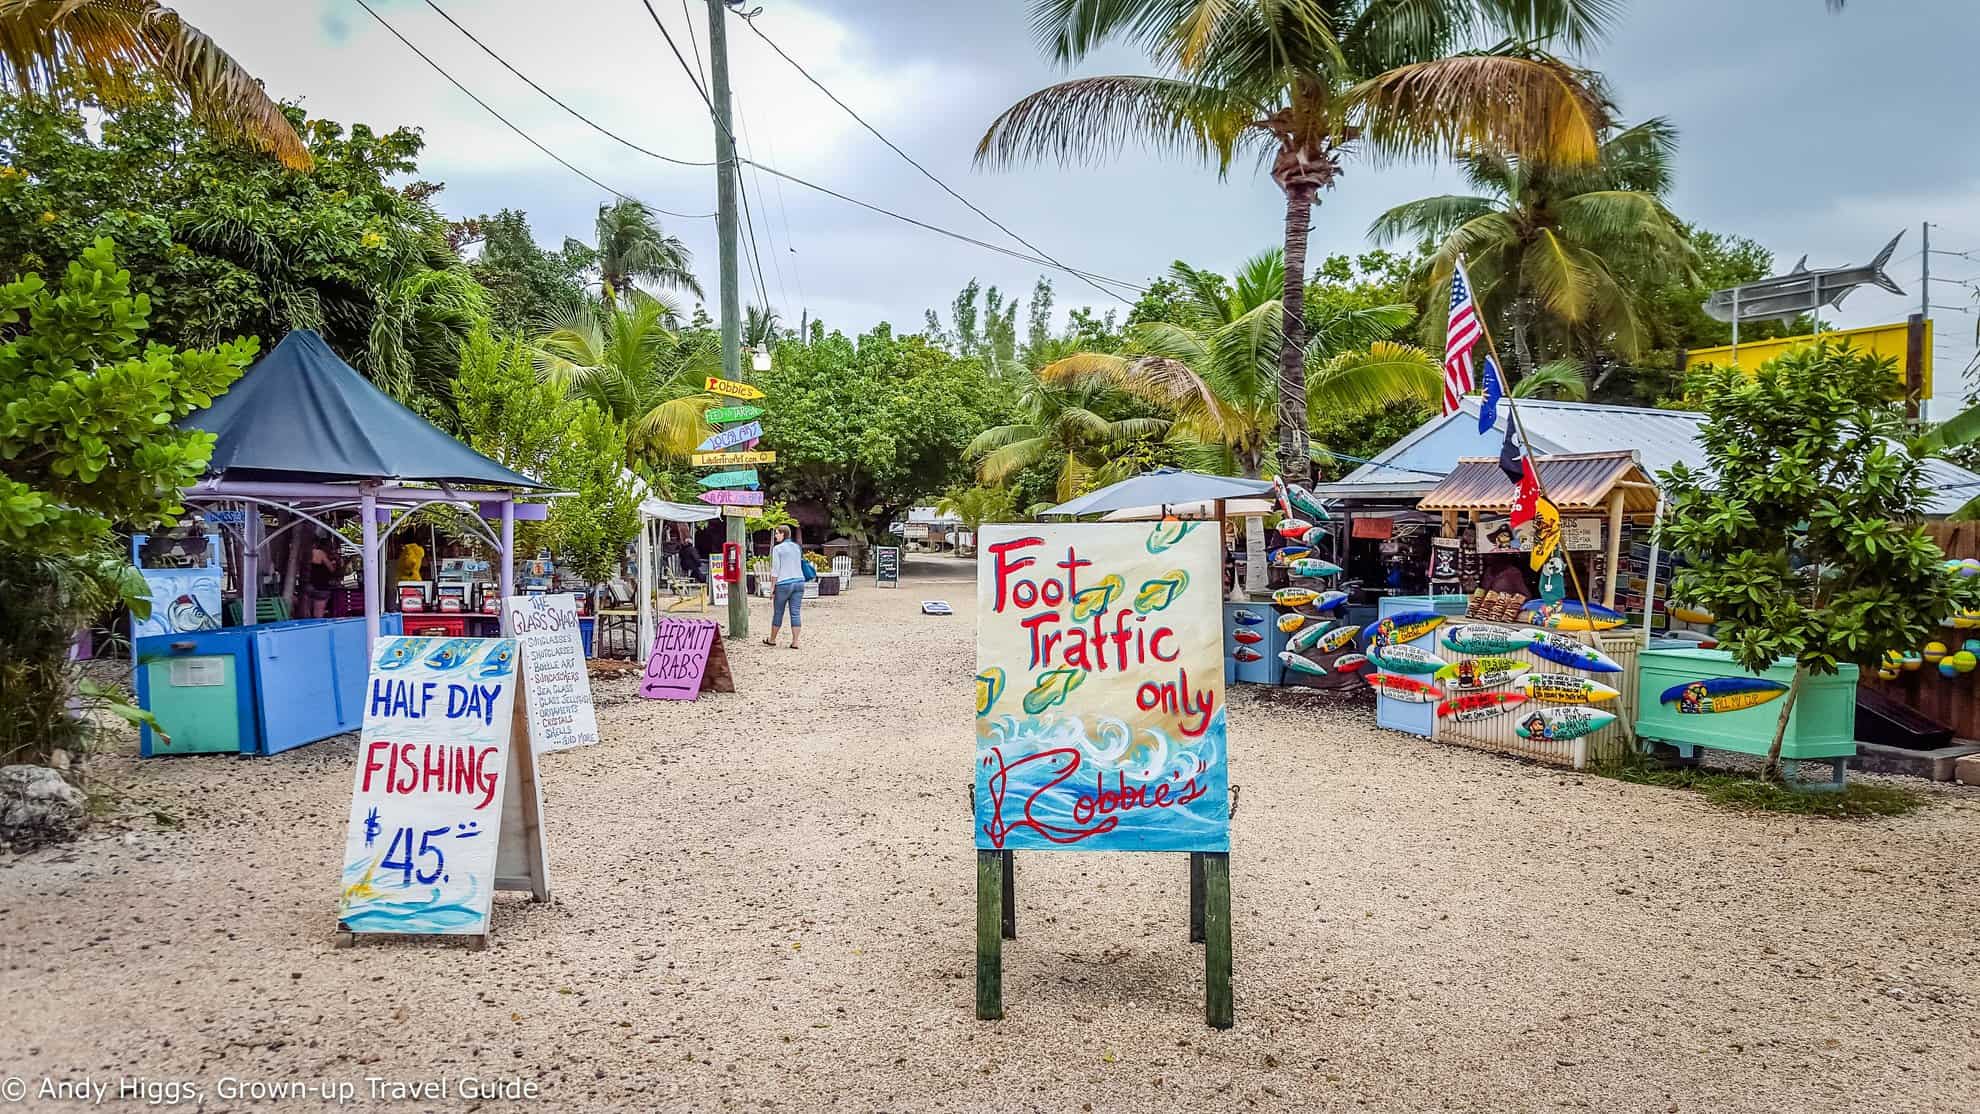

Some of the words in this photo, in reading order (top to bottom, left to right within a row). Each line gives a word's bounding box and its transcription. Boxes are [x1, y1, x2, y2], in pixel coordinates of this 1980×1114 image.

[709, 430, 737, 450] LOCAL
[739, 422, 758, 438] ART
[988, 536, 1093, 614] Foot
[528, 596, 550, 612] THE
[512, 610, 548, 636] GLASS
[655, 622, 715, 653] HERMIT
[1020, 608, 1181, 673] Traffic
[561, 657, 576, 669] ART
[648, 652, 703, 680] CRABS
[371, 678, 437, 719] HALF
[446, 684, 501, 727] DAY
[536, 685, 552, 696] SEA
[553, 683, 574, 695] GLASS
[1136, 667, 1214, 737] only
[1716, 699, 1731, 711] FILL
[1744, 695, 1759, 706] CUP
[545, 725, 573, 739] SHELLS
[577, 732, 596, 744] MORE
[361, 741, 498, 810] FISHING
